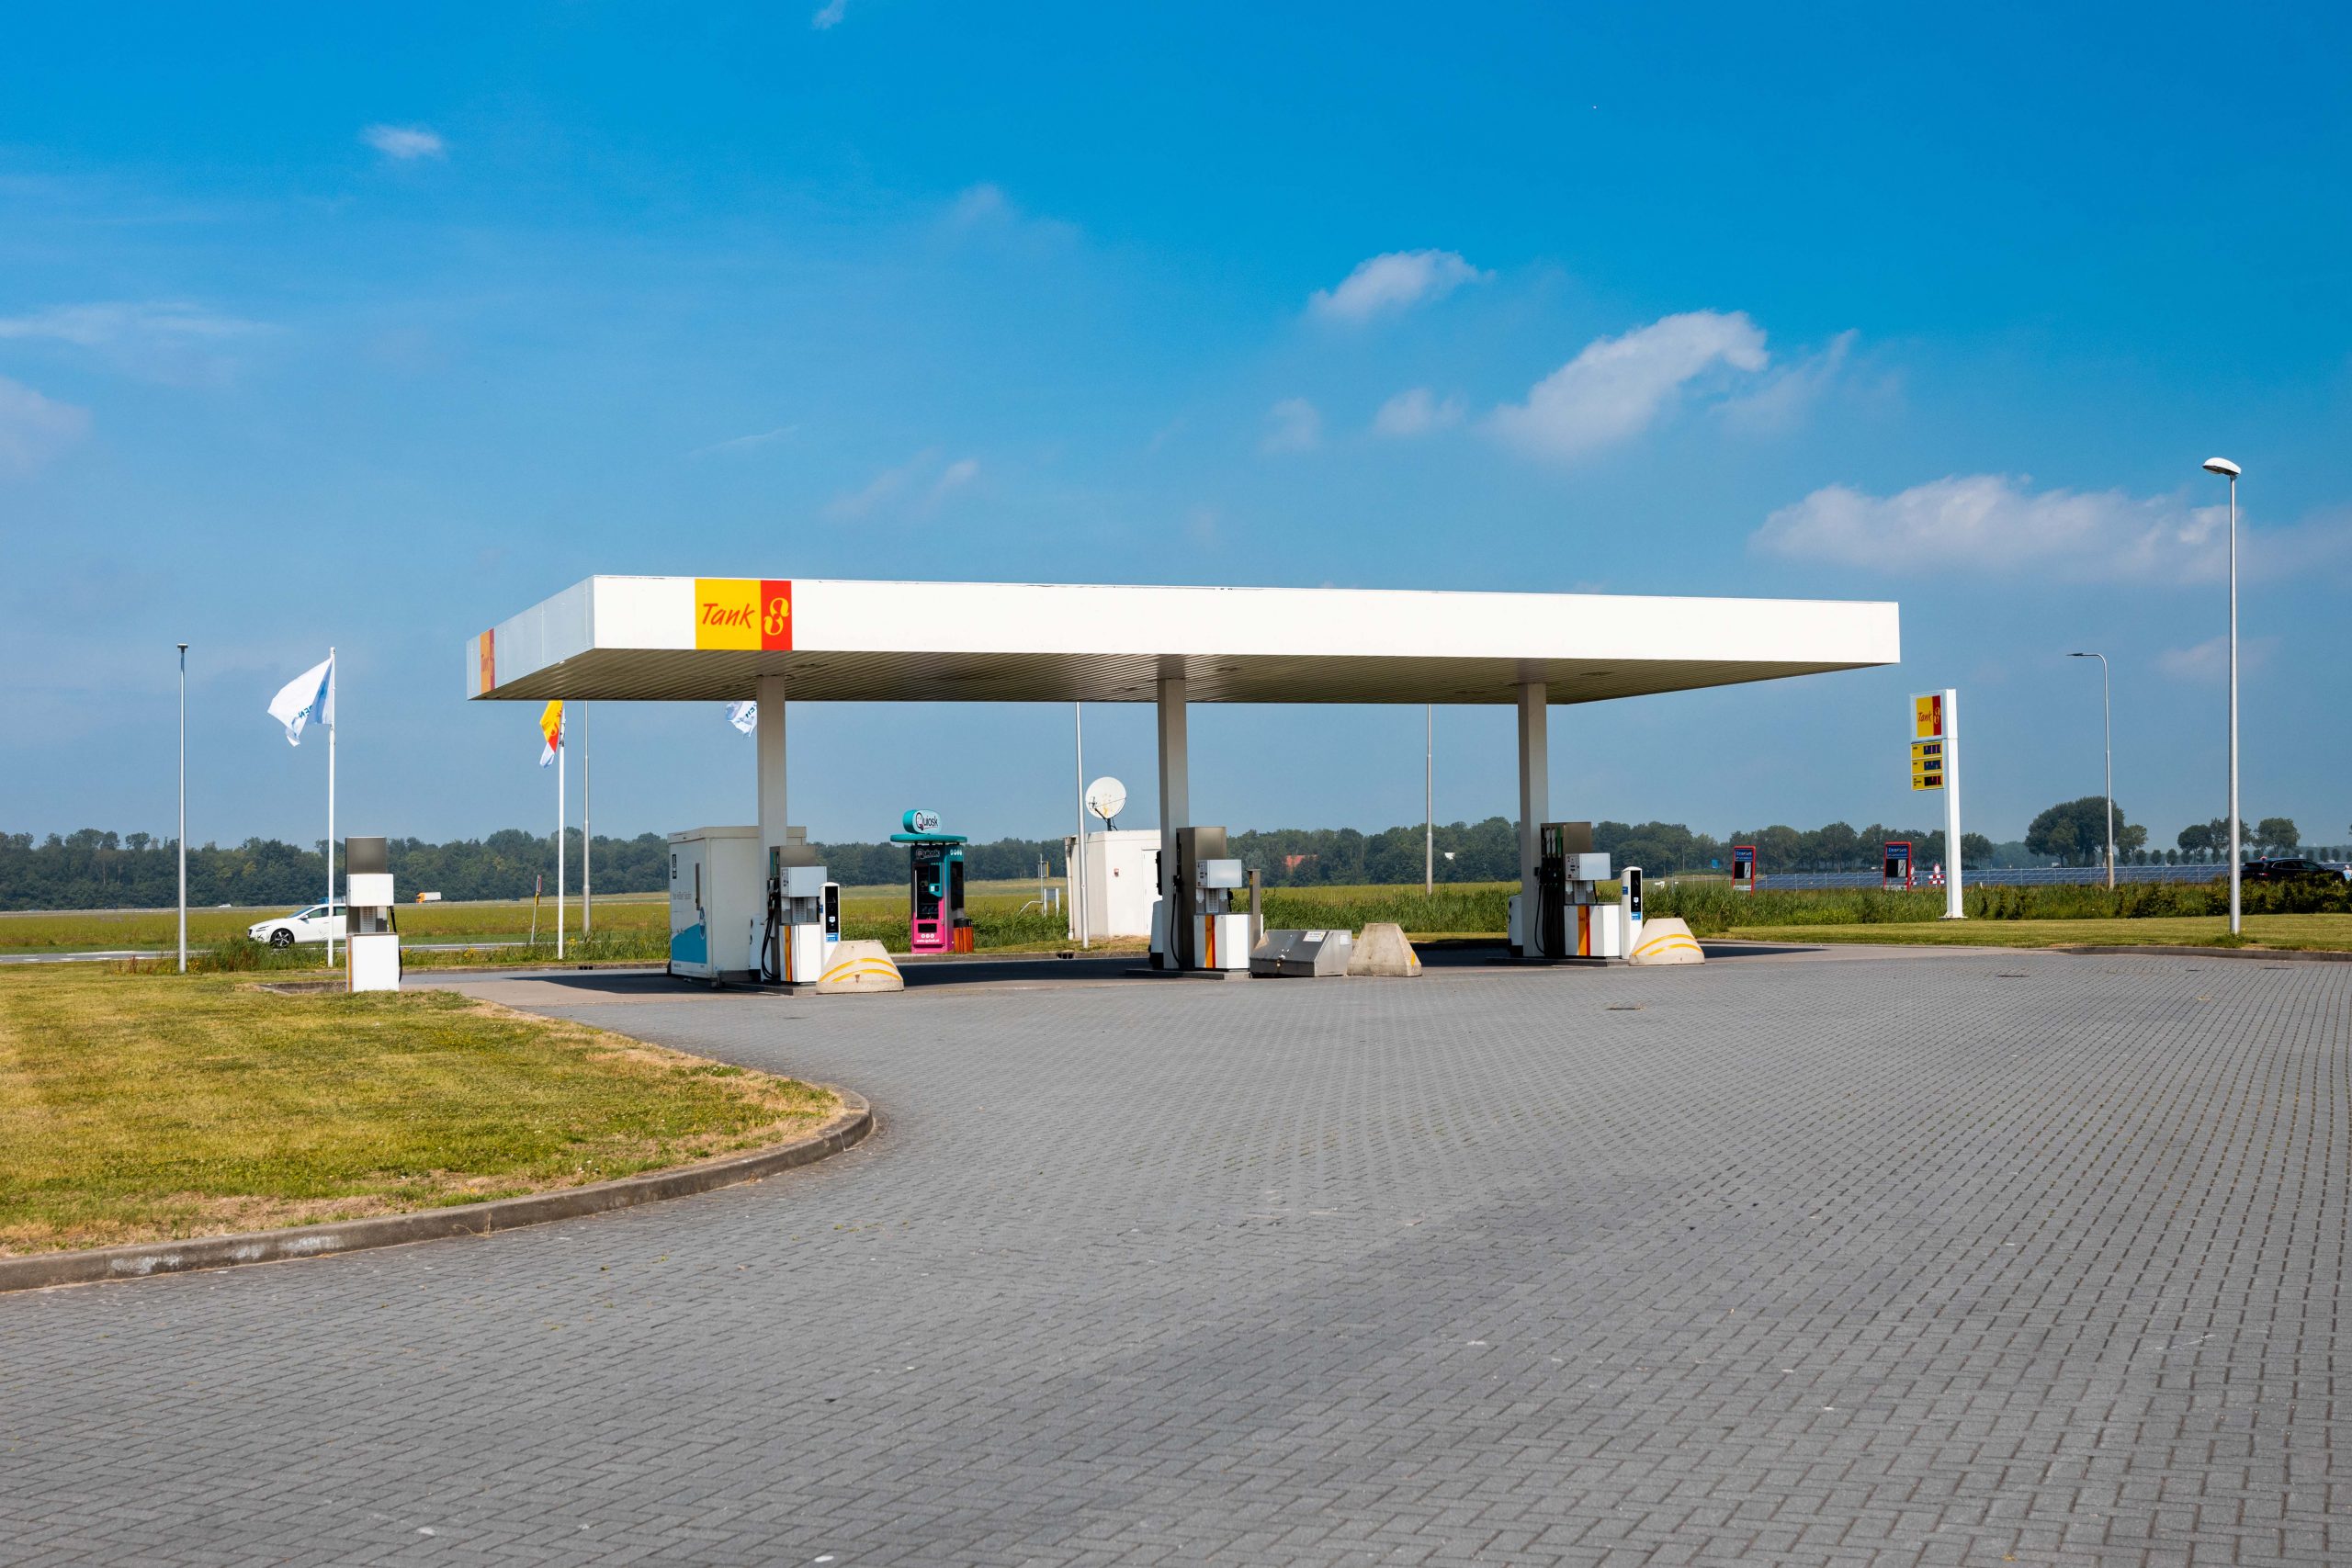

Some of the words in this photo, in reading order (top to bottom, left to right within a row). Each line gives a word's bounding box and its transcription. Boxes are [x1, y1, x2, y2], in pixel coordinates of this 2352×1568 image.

[702, 603, 755, 629] Tank
[1918, 710, 1932, 723] Tank
[916, 812, 939, 830] Quiosk
